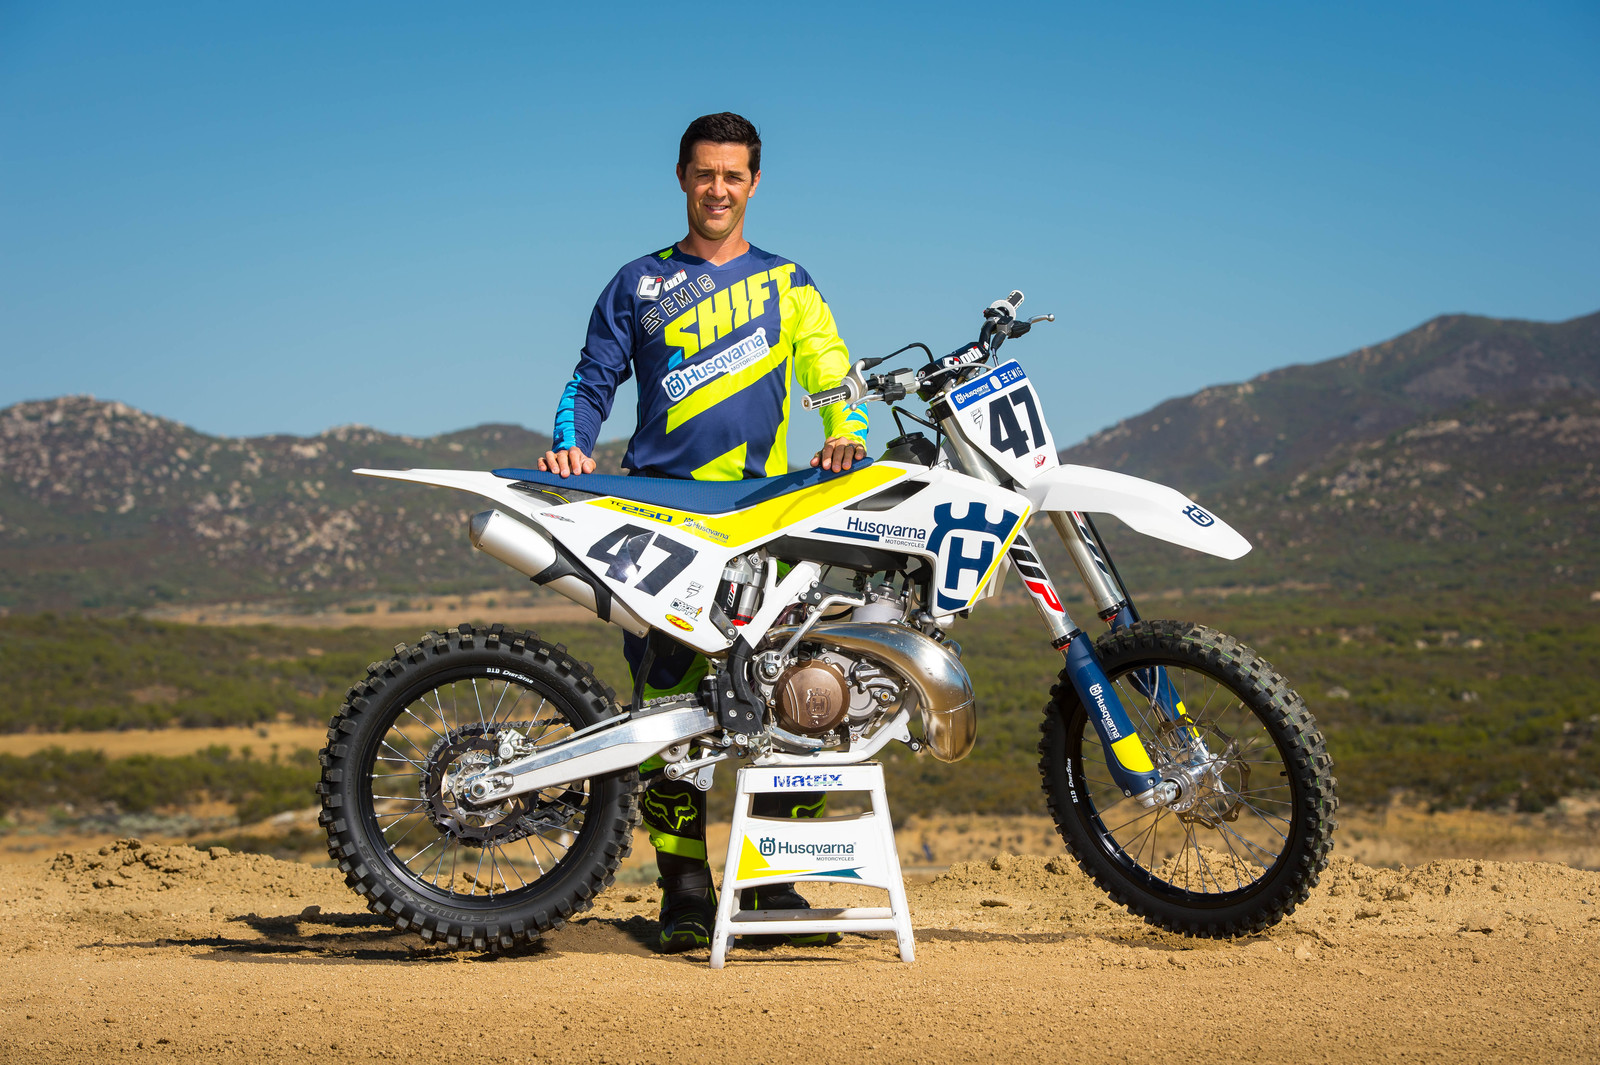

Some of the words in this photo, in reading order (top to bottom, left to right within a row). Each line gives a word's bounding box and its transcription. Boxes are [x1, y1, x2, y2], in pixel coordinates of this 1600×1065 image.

[660, 274, 716, 317] EMIG
[664, 263, 796, 370] SHIFT
[684, 334, 765, 386] Husqvarna
[730, 348, 768, 372] MOTORCYCLES
[988, 384, 1047, 459] 47
[621, 504, 673, 523] 250
[692, 521, 730, 540] Husqvarna
[847, 516, 927, 540] Husqvarna
[885, 539, 925, 549] MOTORCYCLES
[586, 523, 699, 597] 47
[1095, 694, 1120, 739] Husqvarna
[773, 773, 843, 788] Matrix
[778, 841, 854, 856] Husqvarna
